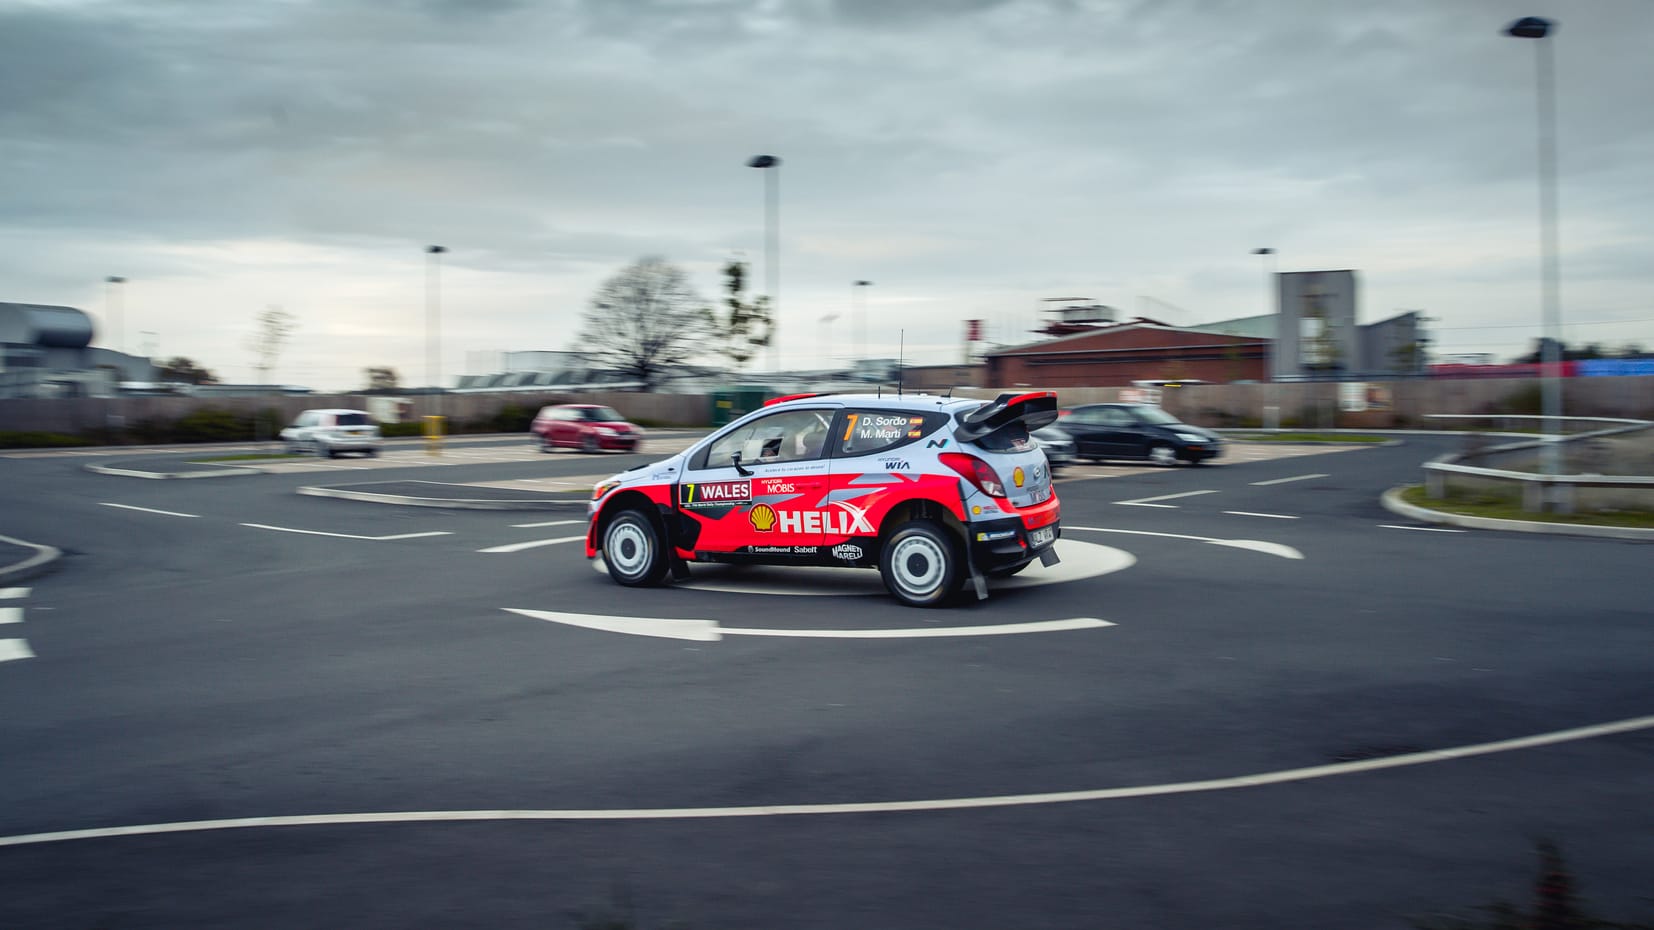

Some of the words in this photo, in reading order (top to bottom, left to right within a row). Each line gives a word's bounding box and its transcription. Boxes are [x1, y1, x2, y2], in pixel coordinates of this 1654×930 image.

[844, 414, 859, 441] 7
[862, 417, 873, 426] D.
[875, 416, 907, 426] Sordo
[860, 429, 873, 439] M.
[686, 483, 695, 503] 7
[701, 484, 749, 499] WALES
[767, 483, 795, 494] MOBIS
[778, 501, 876, 534] HELIX
